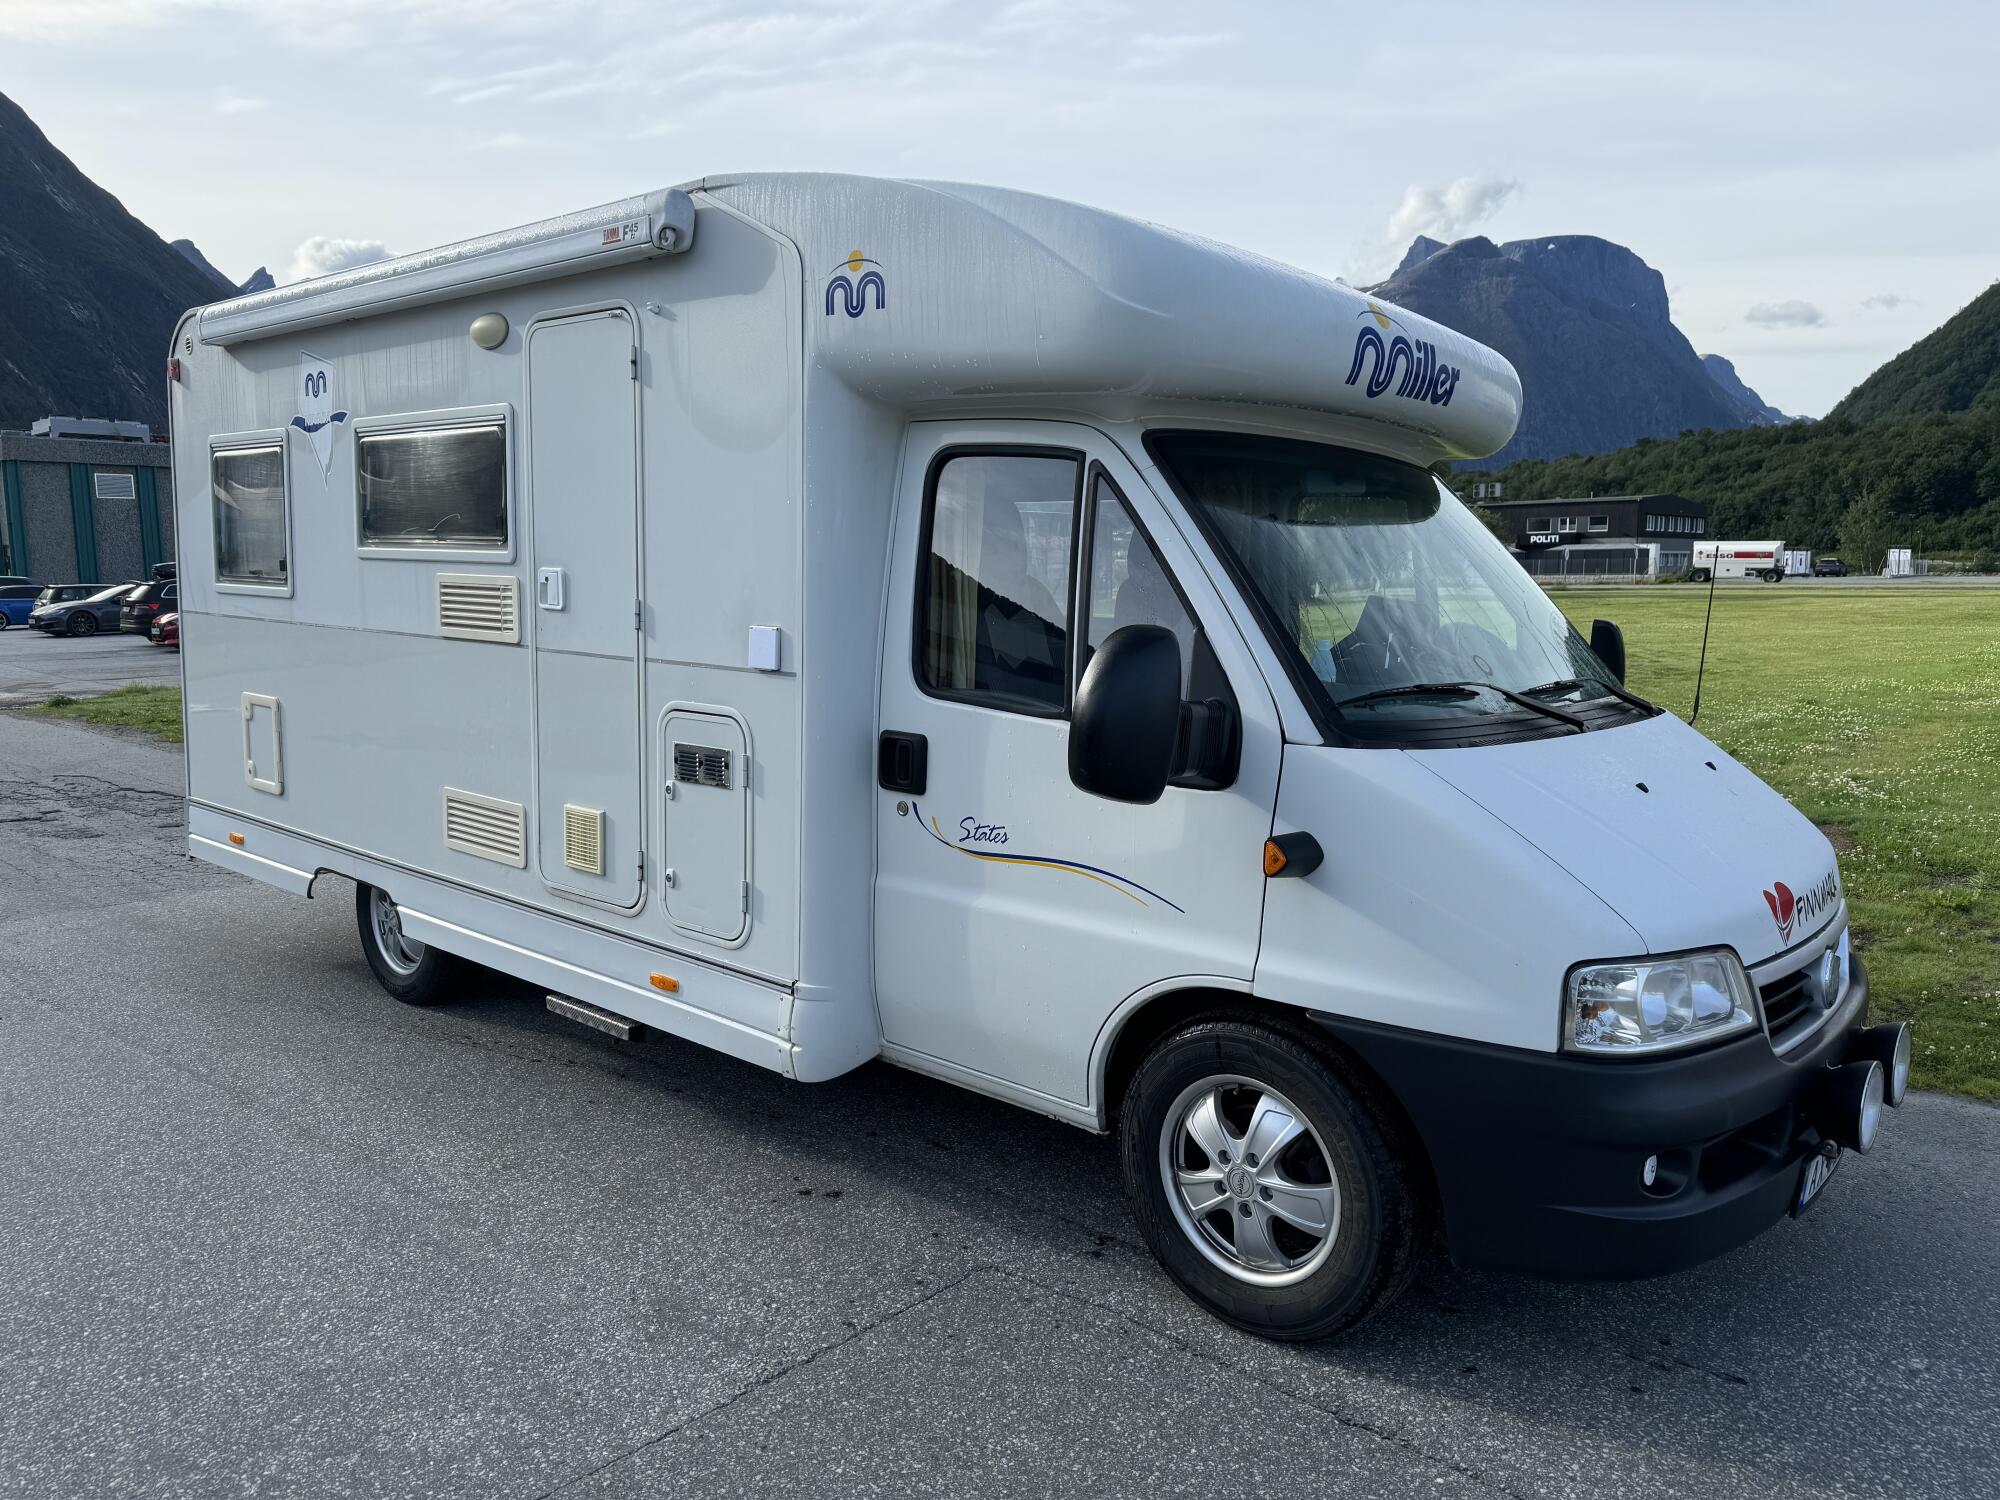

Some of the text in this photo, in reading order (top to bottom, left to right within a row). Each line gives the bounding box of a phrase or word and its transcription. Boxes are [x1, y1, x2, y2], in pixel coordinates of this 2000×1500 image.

[1345, 326, 1461, 407] Miller
[1530, 534, 1559, 544] POLITI
[959, 816, 1009, 844] States
